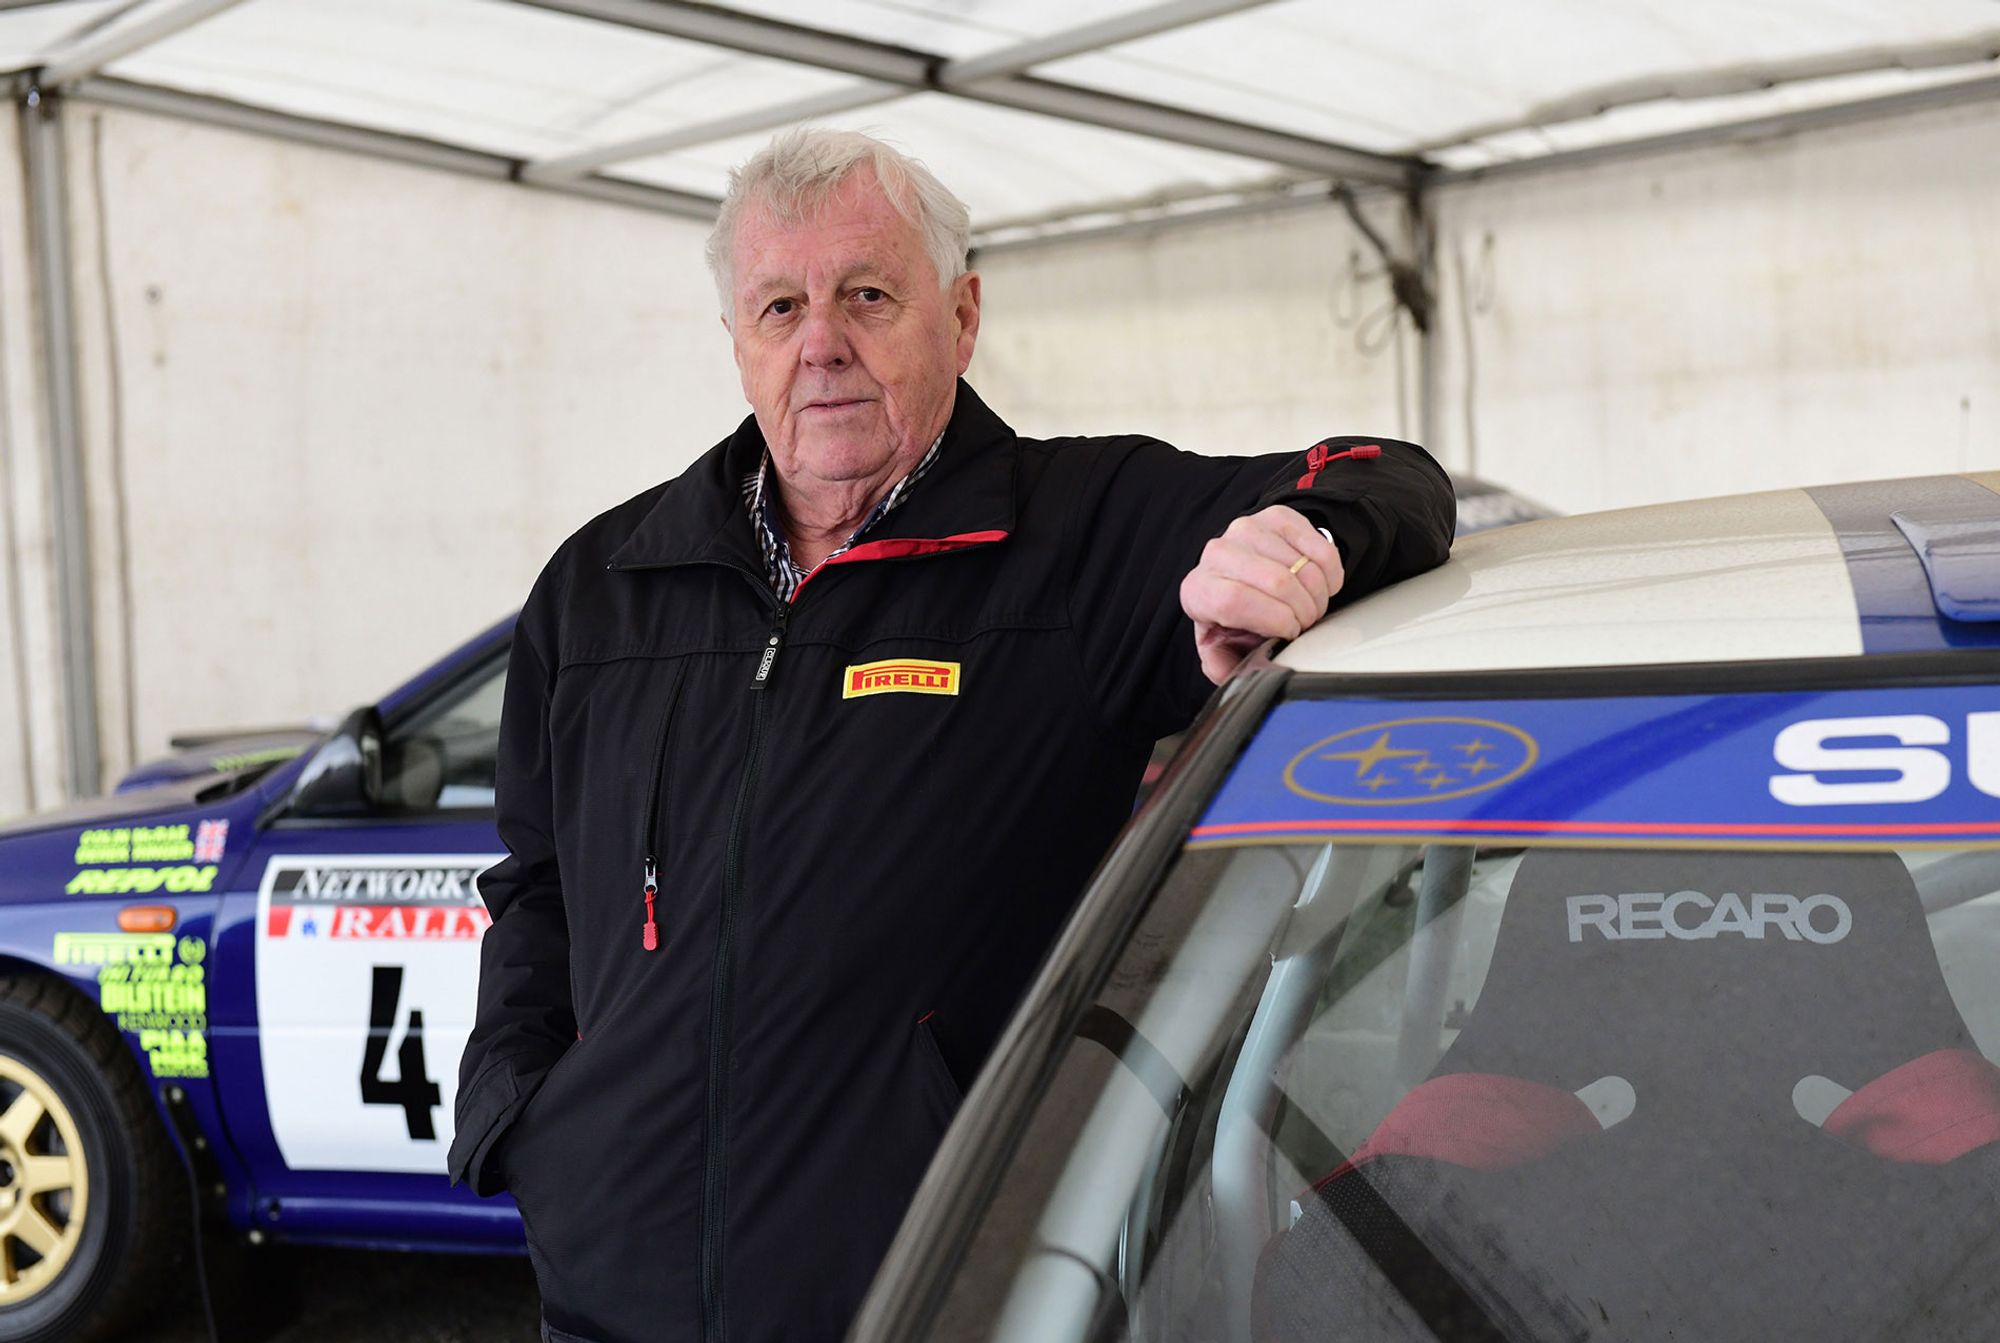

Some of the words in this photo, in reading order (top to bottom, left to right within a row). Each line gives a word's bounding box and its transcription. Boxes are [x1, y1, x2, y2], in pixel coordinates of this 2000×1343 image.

[852, 665, 951, 690] PIRELLI
[1769, 711, 2000, 806] S
[339, 907, 492, 937] RALLY
[1566, 890, 1852, 944] RECARO
[361, 965, 442, 1140] 4
